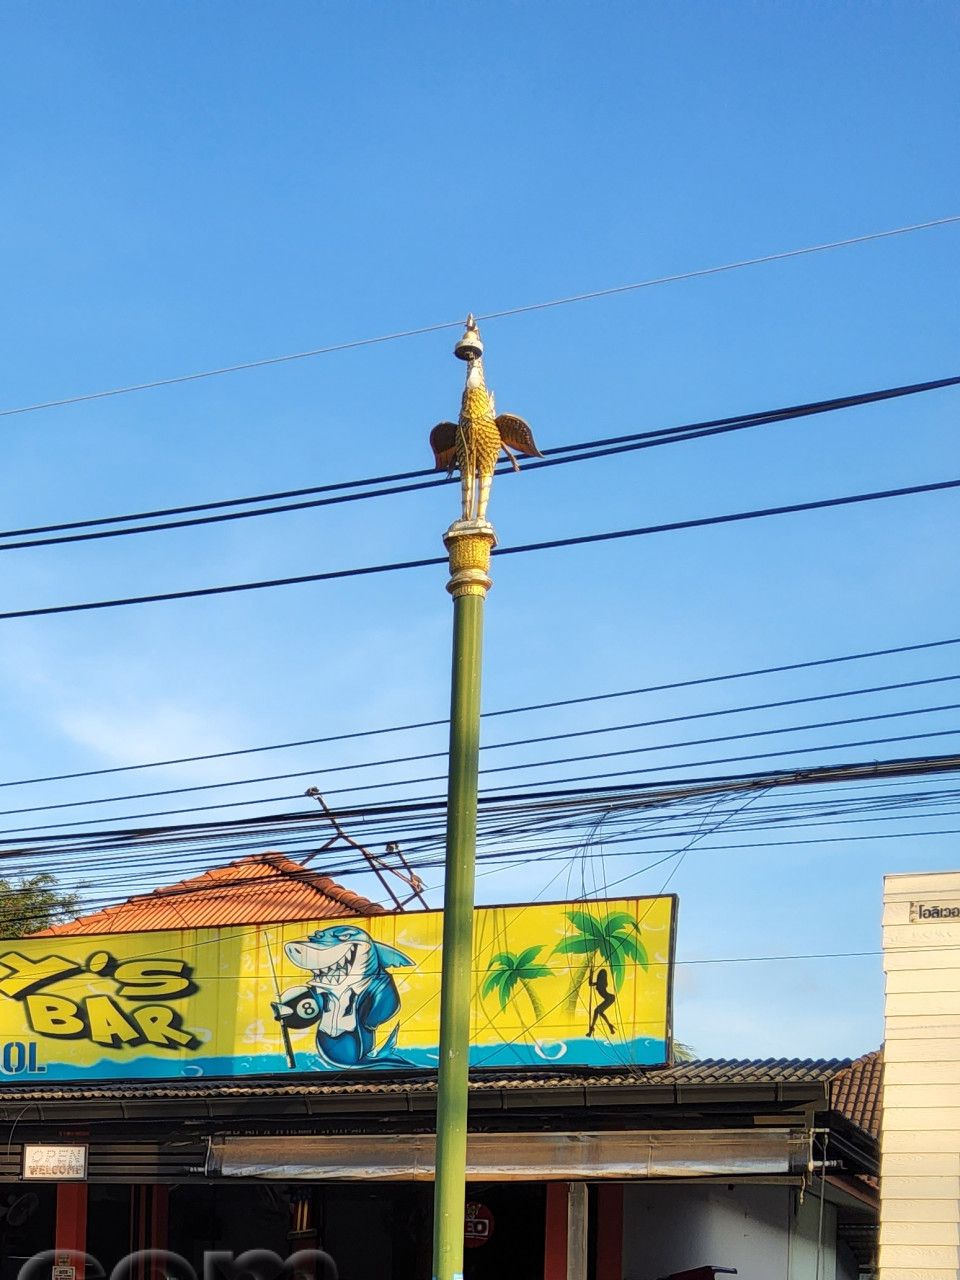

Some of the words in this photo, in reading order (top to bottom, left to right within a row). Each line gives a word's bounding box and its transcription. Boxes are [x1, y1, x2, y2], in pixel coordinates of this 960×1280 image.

[302, 1001, 315, 1016] 8
[27, 994, 201, 1052] BAR
[32, 1148, 82, 1164] OPEN
[29, 1164, 84, 1176] WELCOME
